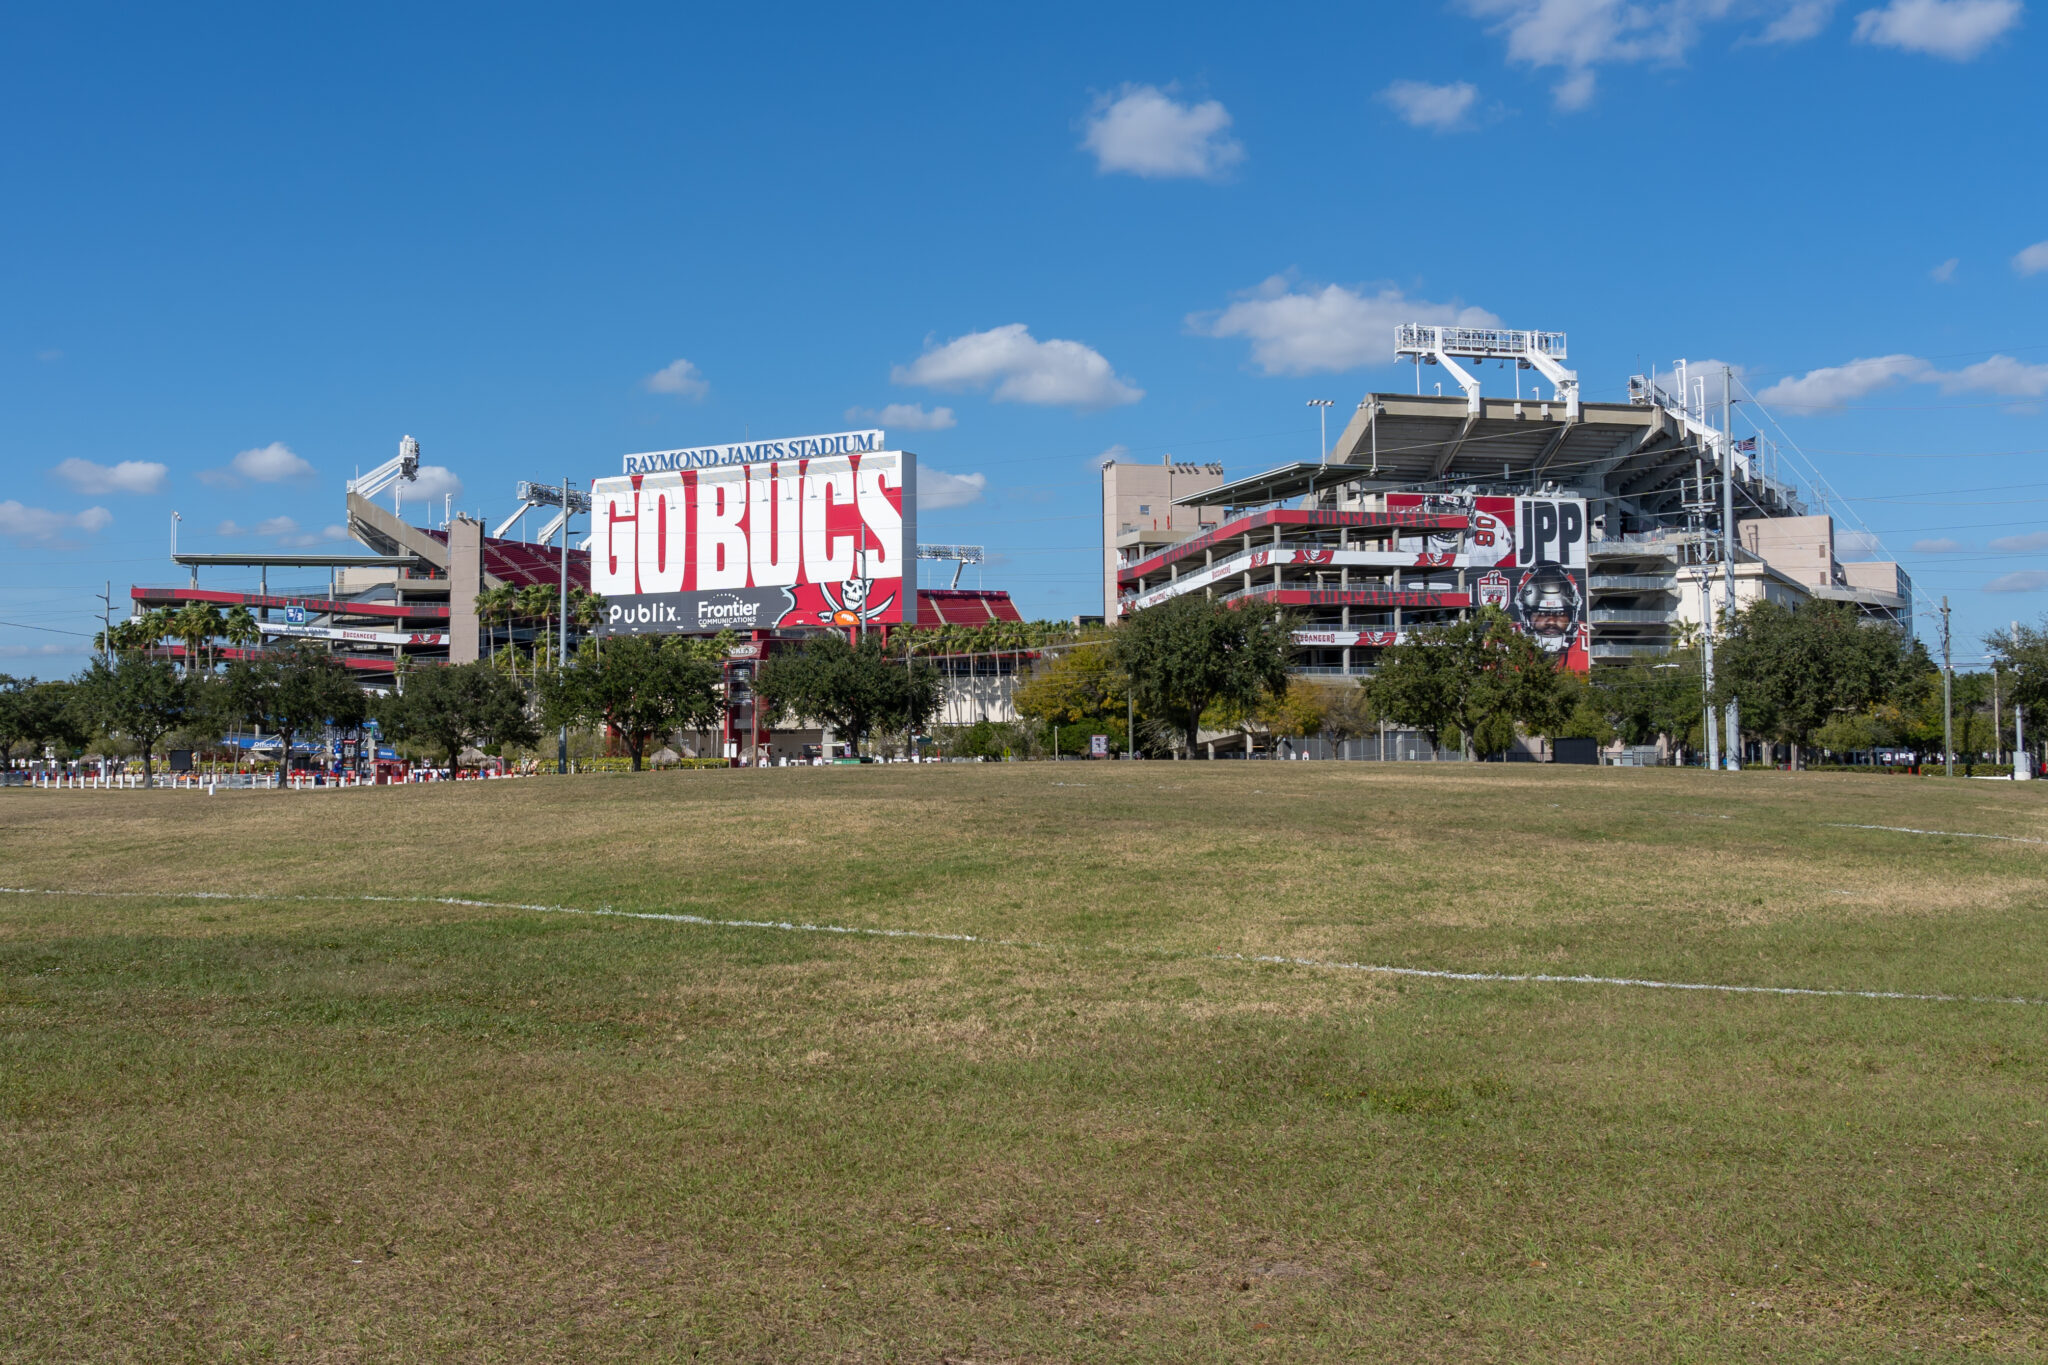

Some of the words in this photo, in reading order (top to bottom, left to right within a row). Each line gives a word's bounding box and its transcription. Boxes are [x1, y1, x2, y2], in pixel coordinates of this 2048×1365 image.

[625, 448, 719, 475] RAYMOND
[721, 442, 785, 466] JAMES
[788, 433, 875, 459] STADIUM
[591, 475, 686, 596] GO
[696, 453, 902, 587] BUCS
[1308, 510, 1440, 528] BUCCANEERS
[1519, 500, 1582, 566] JPP
[1309, 590, 1442, 606] BUCCANEERS
[698, 601, 760, 618] Frontier
[698, 617, 757, 625] COMMUNICATIONS
[342, 631, 377, 640] BUCCANEERS
